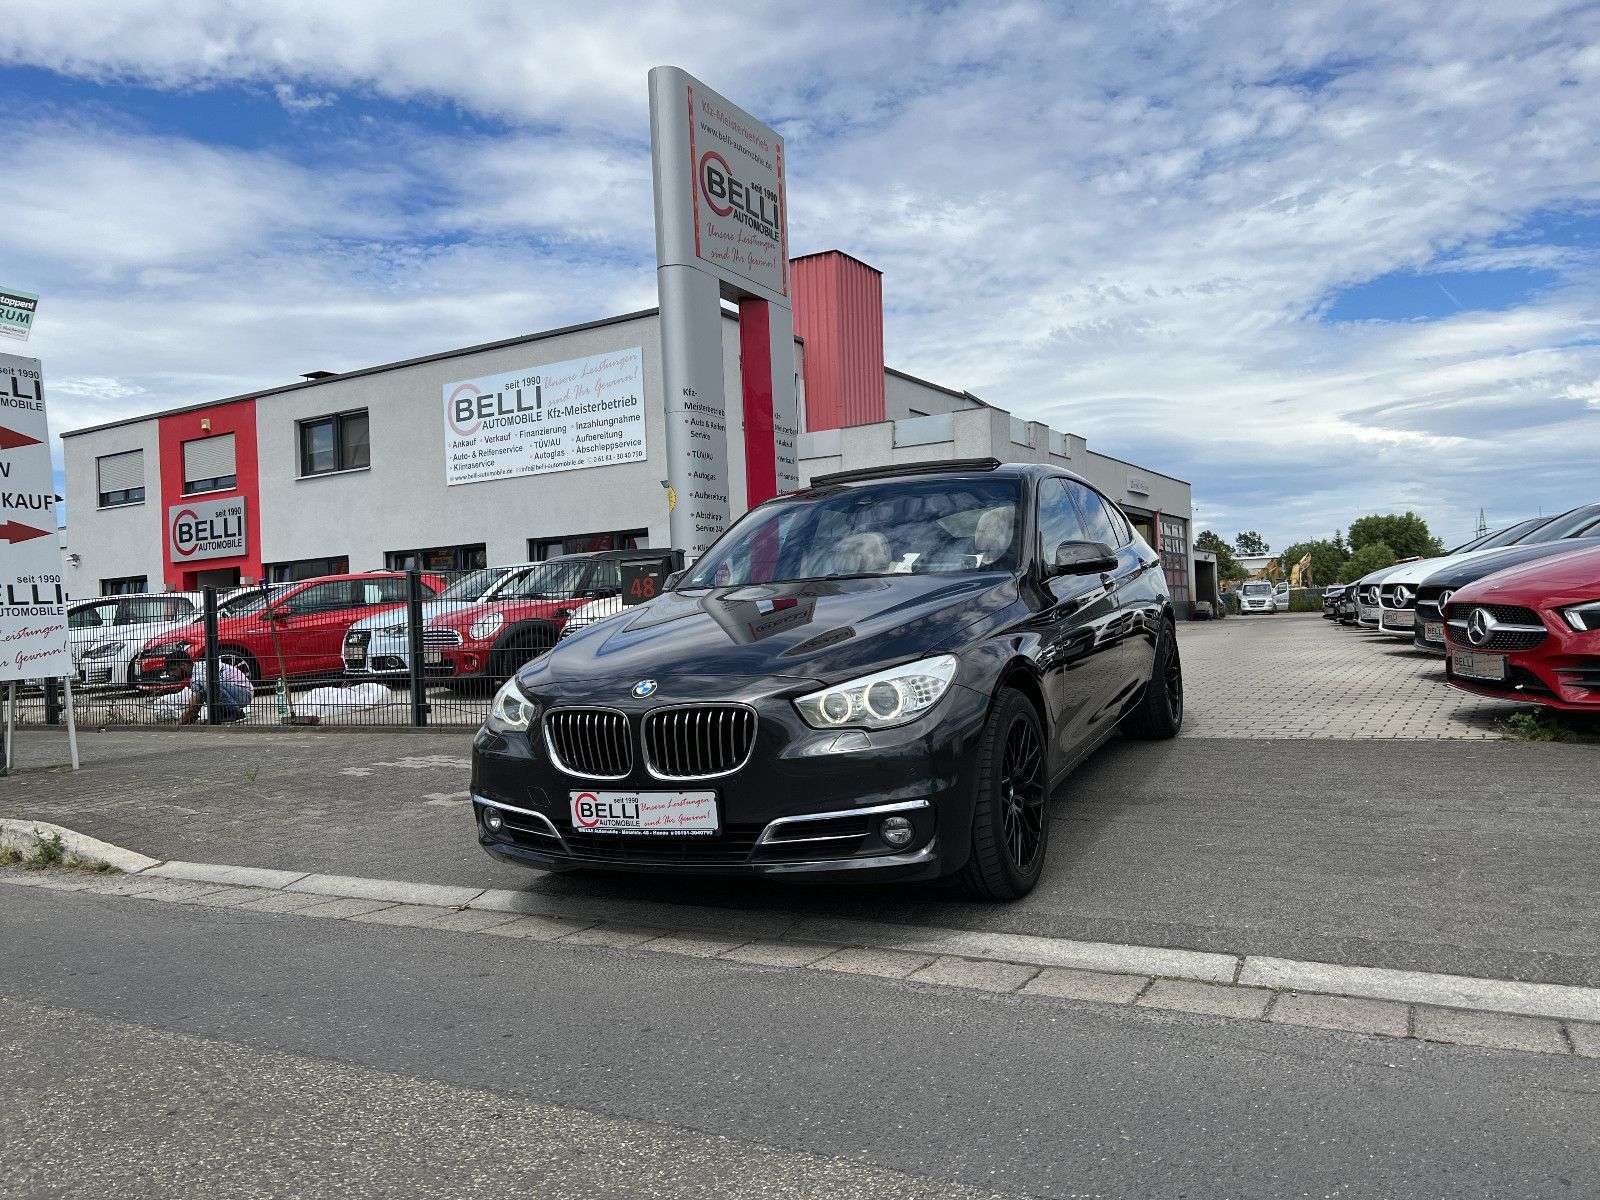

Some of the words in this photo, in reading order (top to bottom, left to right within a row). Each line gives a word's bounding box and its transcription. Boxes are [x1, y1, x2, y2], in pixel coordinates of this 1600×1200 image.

[707, 166, 779, 230] BELLI
[733, 209, 779, 242] AUTOMOBILE
[18, 368, 40, 379] 1990
[505, 380, 520, 391] seit
[522, 375, 541, 387] 1990
[683, 388, 697, 396] Kfz-
[455, 385, 542, 422] BELLI
[547, 394, 638, 419] Kfz-Meisterbetrieb
[482, 411, 542, 431] AUTOMOBILE
[452, 438, 477, 449] Ankauf
[484, 432, 511, 443] Verkauf
[519, 425, 567, 438] Finanzierung
[576, 414, 641, 430] Inzahlungnahme
[575, 430, 623, 443] Aufbereitung
[478, 444, 523, 458] Reifenservice
[534, 448, 566, 460] Autoglas
[576, 438, 642, 454] Abschleppservice
[453, 460, 495, 471] Klimaservice
[215, 508, 226, 518] seit
[228, 507, 241, 516] 1990
[178, 515, 242, 543] BELLI
[198, 538, 242, 551] AUTOMOBILE
[17, 575, 35, 584] seit
[38, 574, 61, 583] 1990
[631, 576, 655, 598] 48
[15, 640, 66, 670] Gewinn!
[581, 803, 639, 819] BELLI
